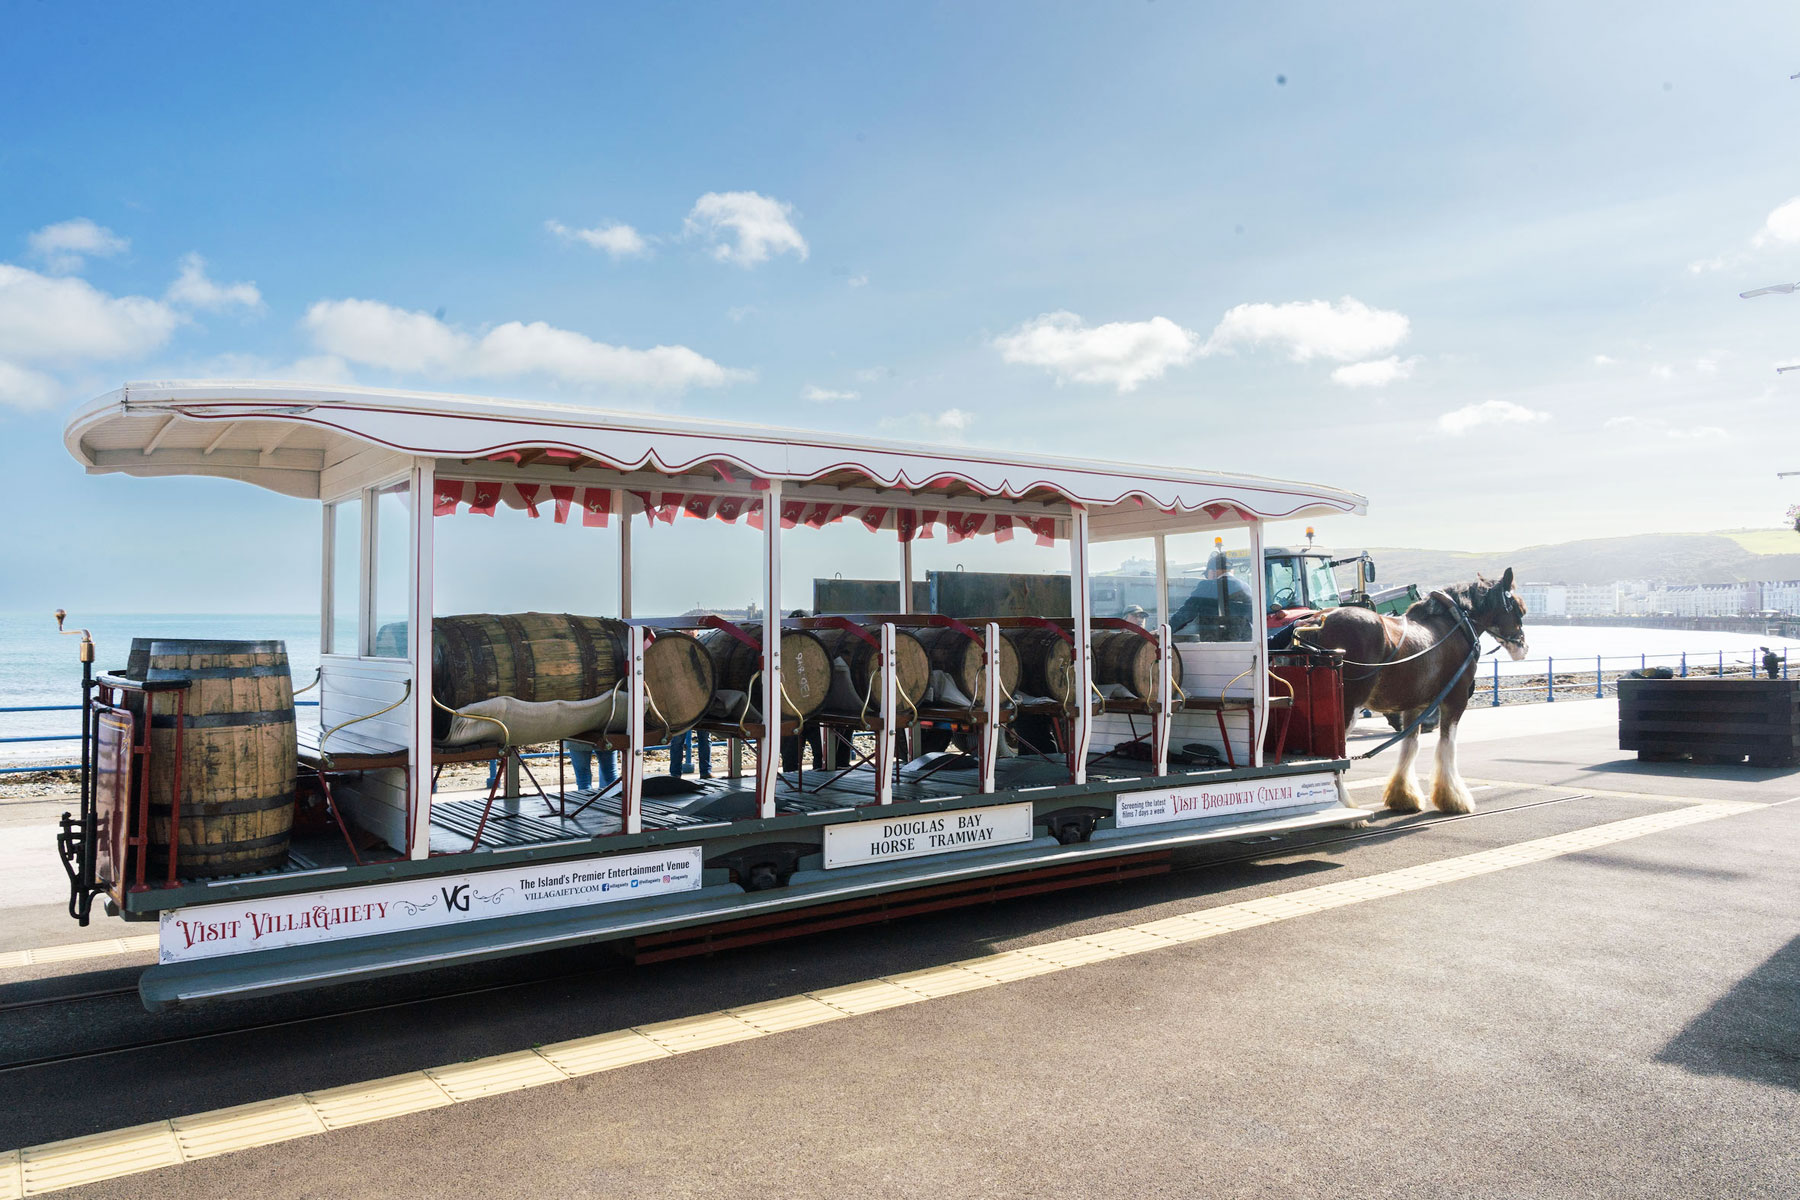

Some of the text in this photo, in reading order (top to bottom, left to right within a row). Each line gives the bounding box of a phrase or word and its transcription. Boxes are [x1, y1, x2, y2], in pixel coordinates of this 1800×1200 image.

[1121, 801, 1144, 810] Screening
[1153, 798, 1166, 806] latest
[1122, 810, 1134, 818] films
[1138, 808, 1149, 817] days
[1169, 786, 1292, 816] VISIT BROADWAY CINEMA
[883, 814, 982, 838] DOUGLAS BAY
[871, 828, 994, 855] HORSE TRAMWAY
[520, 861, 690, 890] The Island's Premier Entertainment Venue
[441, 884, 470, 912] VG
[524, 884, 600, 901] VILLAGAIETY.COM
[176, 920, 241, 949] VISIT
